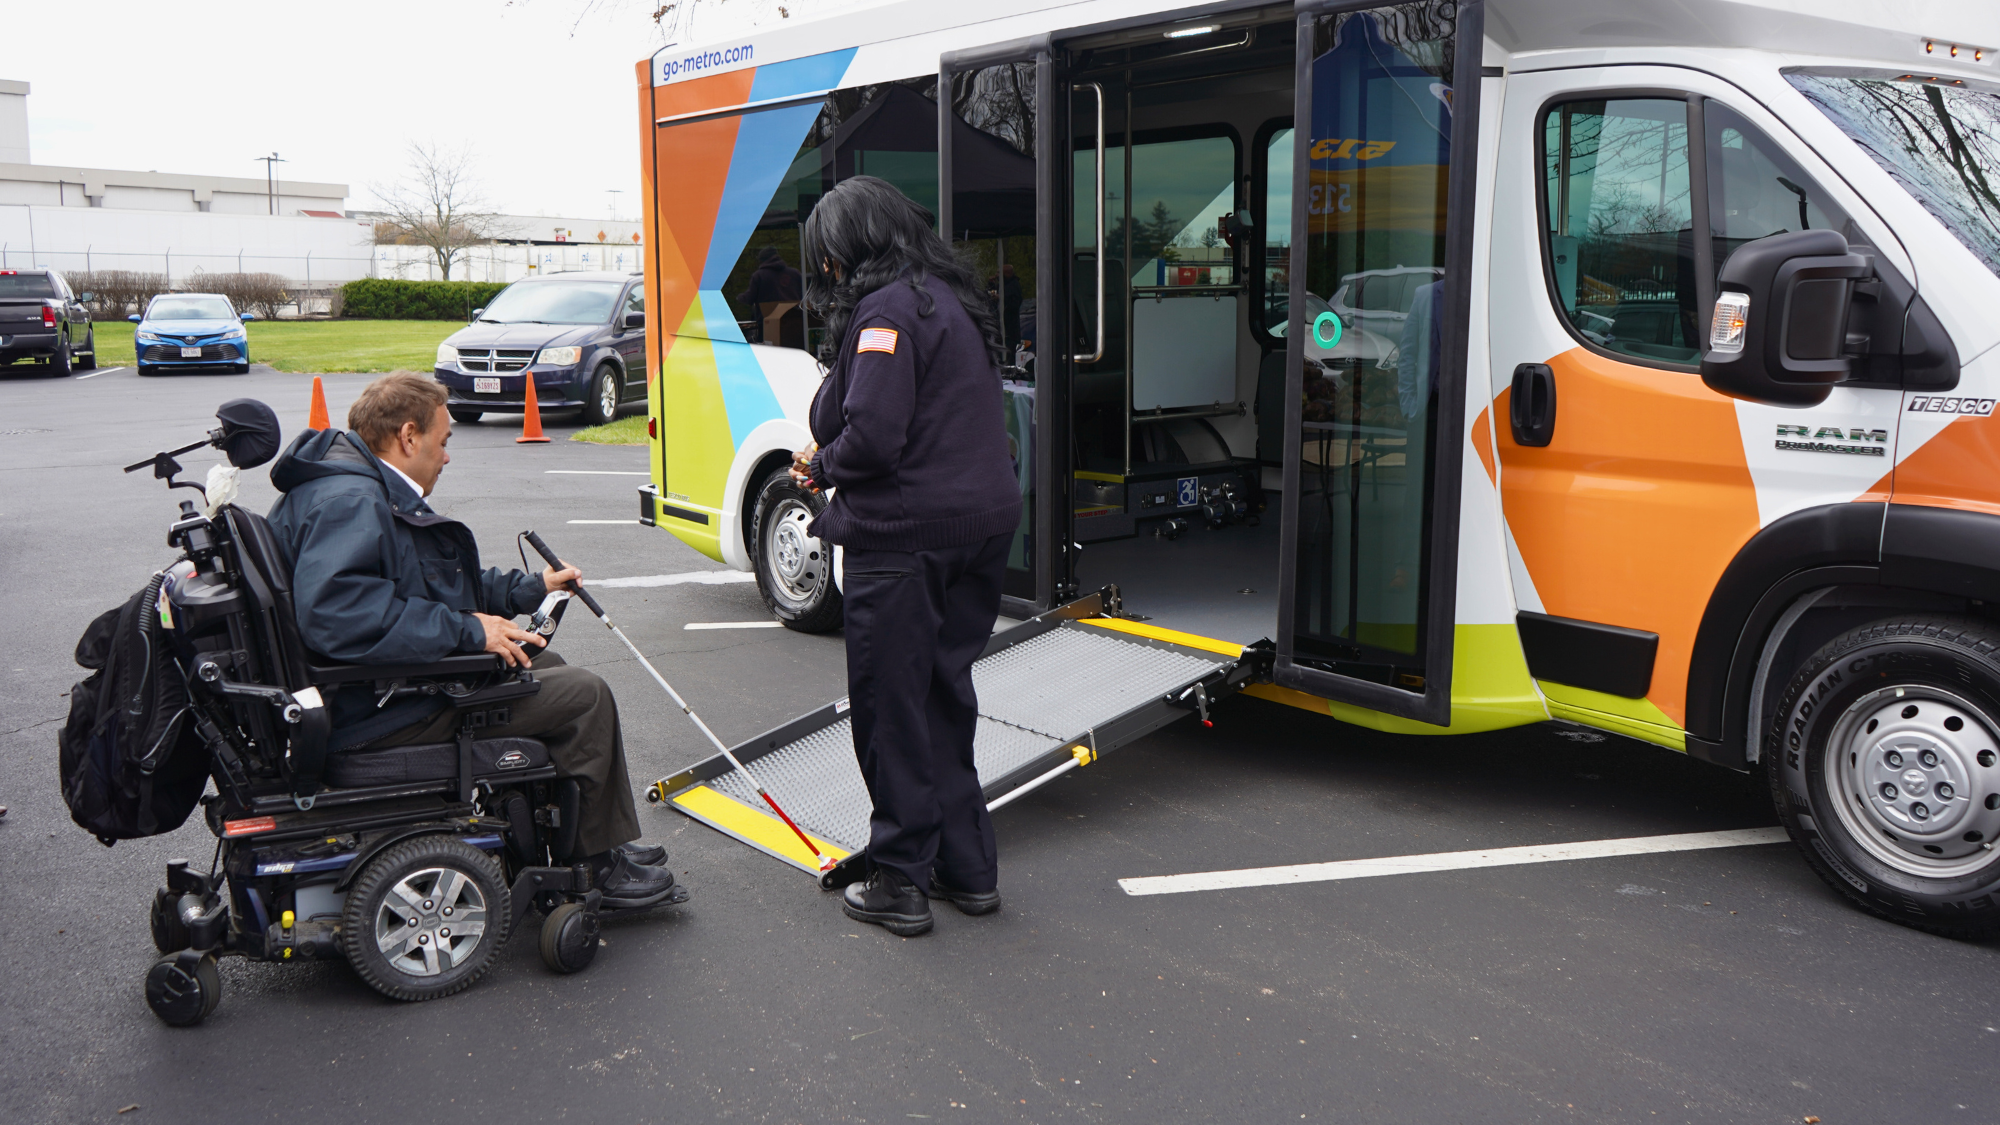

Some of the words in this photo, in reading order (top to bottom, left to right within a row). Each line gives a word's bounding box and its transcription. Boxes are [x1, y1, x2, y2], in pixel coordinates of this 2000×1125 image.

[663, 44, 753, 82] go-metro.com
[1909, 396, 1995, 416] TESCO
[1776, 424, 1888, 442] RAM
[1786, 669, 1844, 771] ROADIAN
